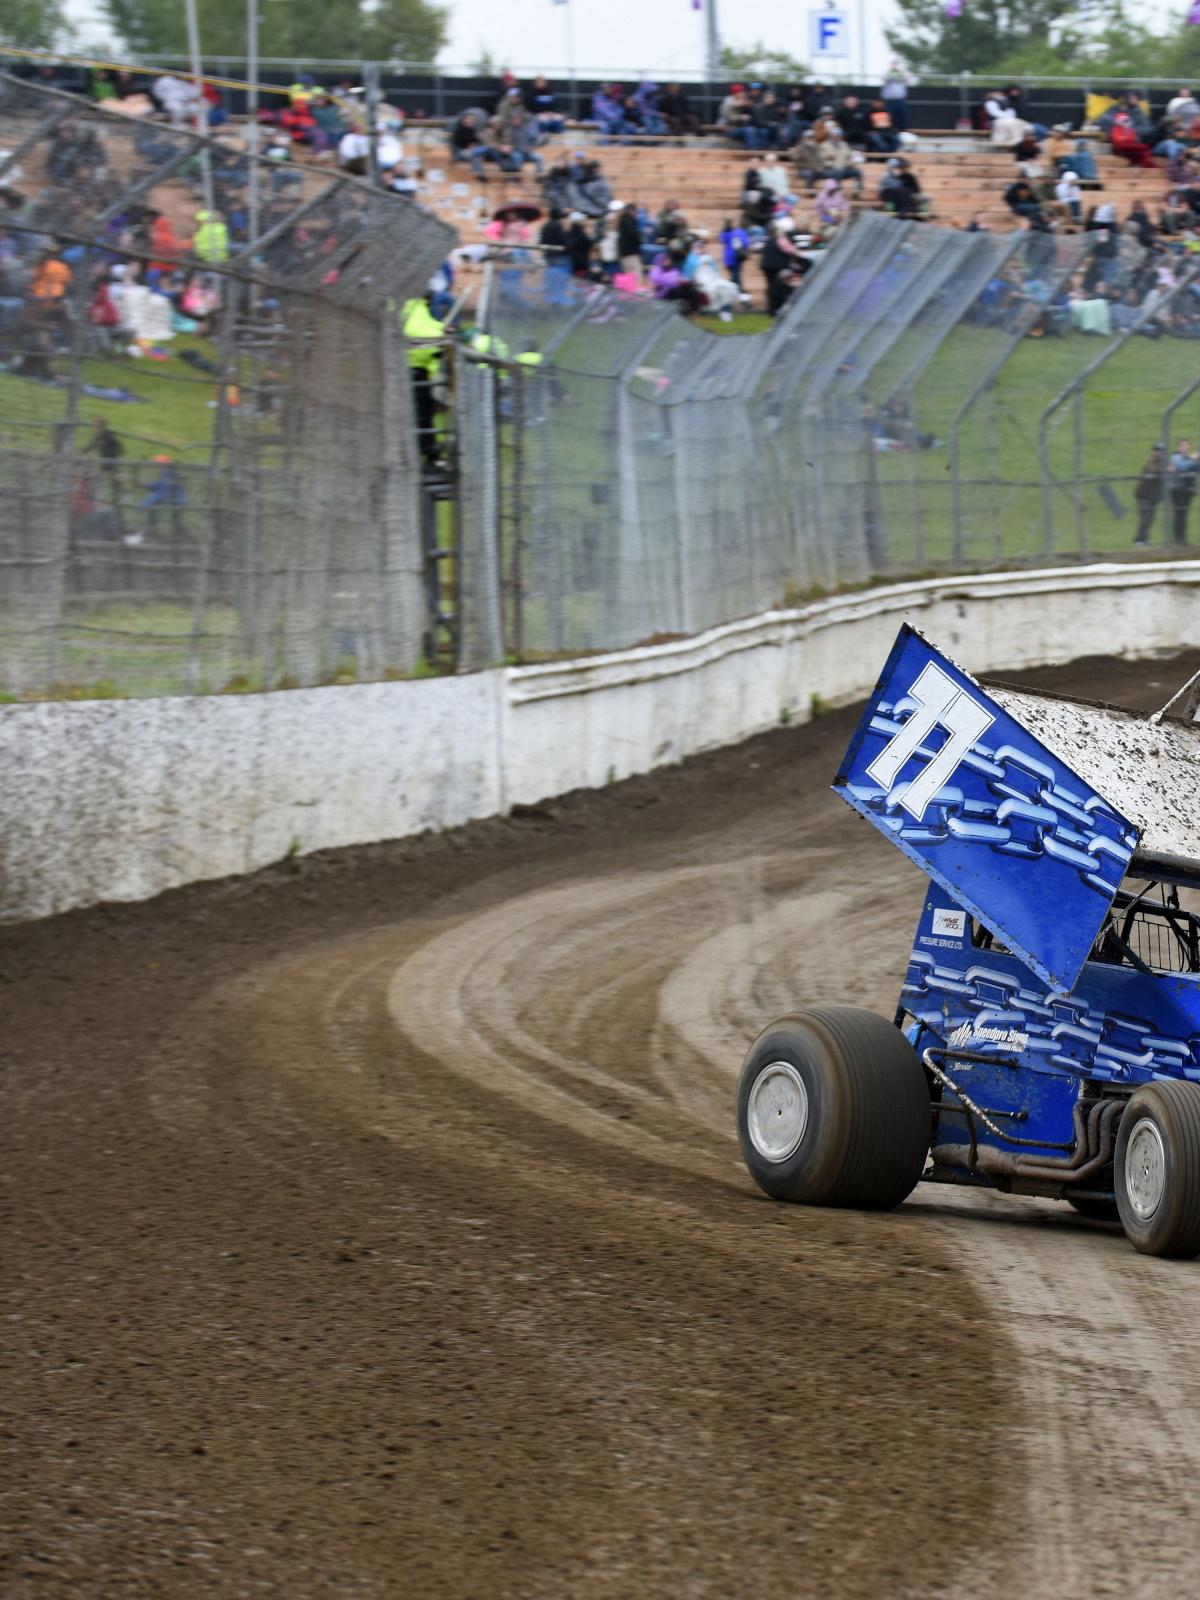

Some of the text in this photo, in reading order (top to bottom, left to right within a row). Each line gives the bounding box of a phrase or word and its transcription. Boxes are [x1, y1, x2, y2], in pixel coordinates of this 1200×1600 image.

[818, 17, 841, 49] F
[865, 660, 996, 822] 77
[973, 1026, 1008, 1041] Speedpro
